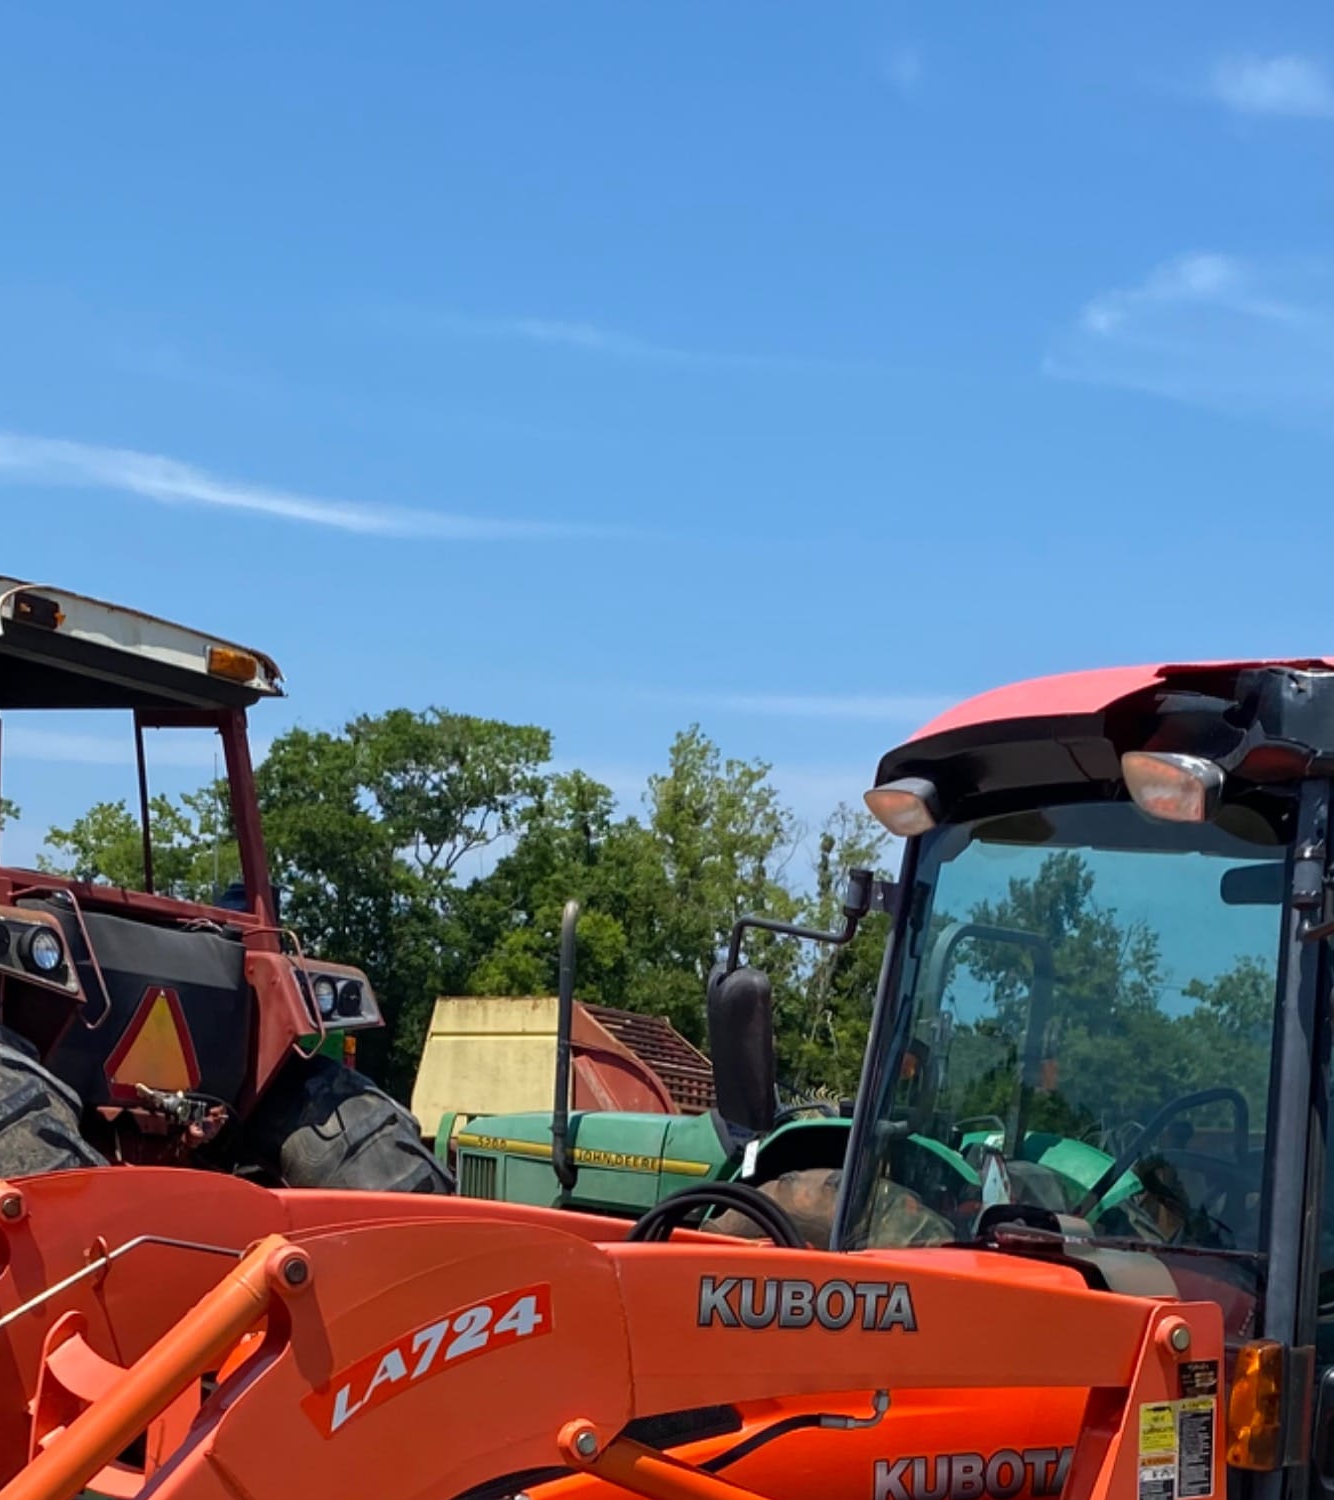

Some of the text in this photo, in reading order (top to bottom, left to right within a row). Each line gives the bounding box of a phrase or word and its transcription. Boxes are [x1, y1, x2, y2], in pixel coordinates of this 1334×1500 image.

[578, 1149, 655, 1170] JOHN DEERE
[698, 1275, 917, 1331] KUBOTA
[331, 1296, 543, 1432] LA724
